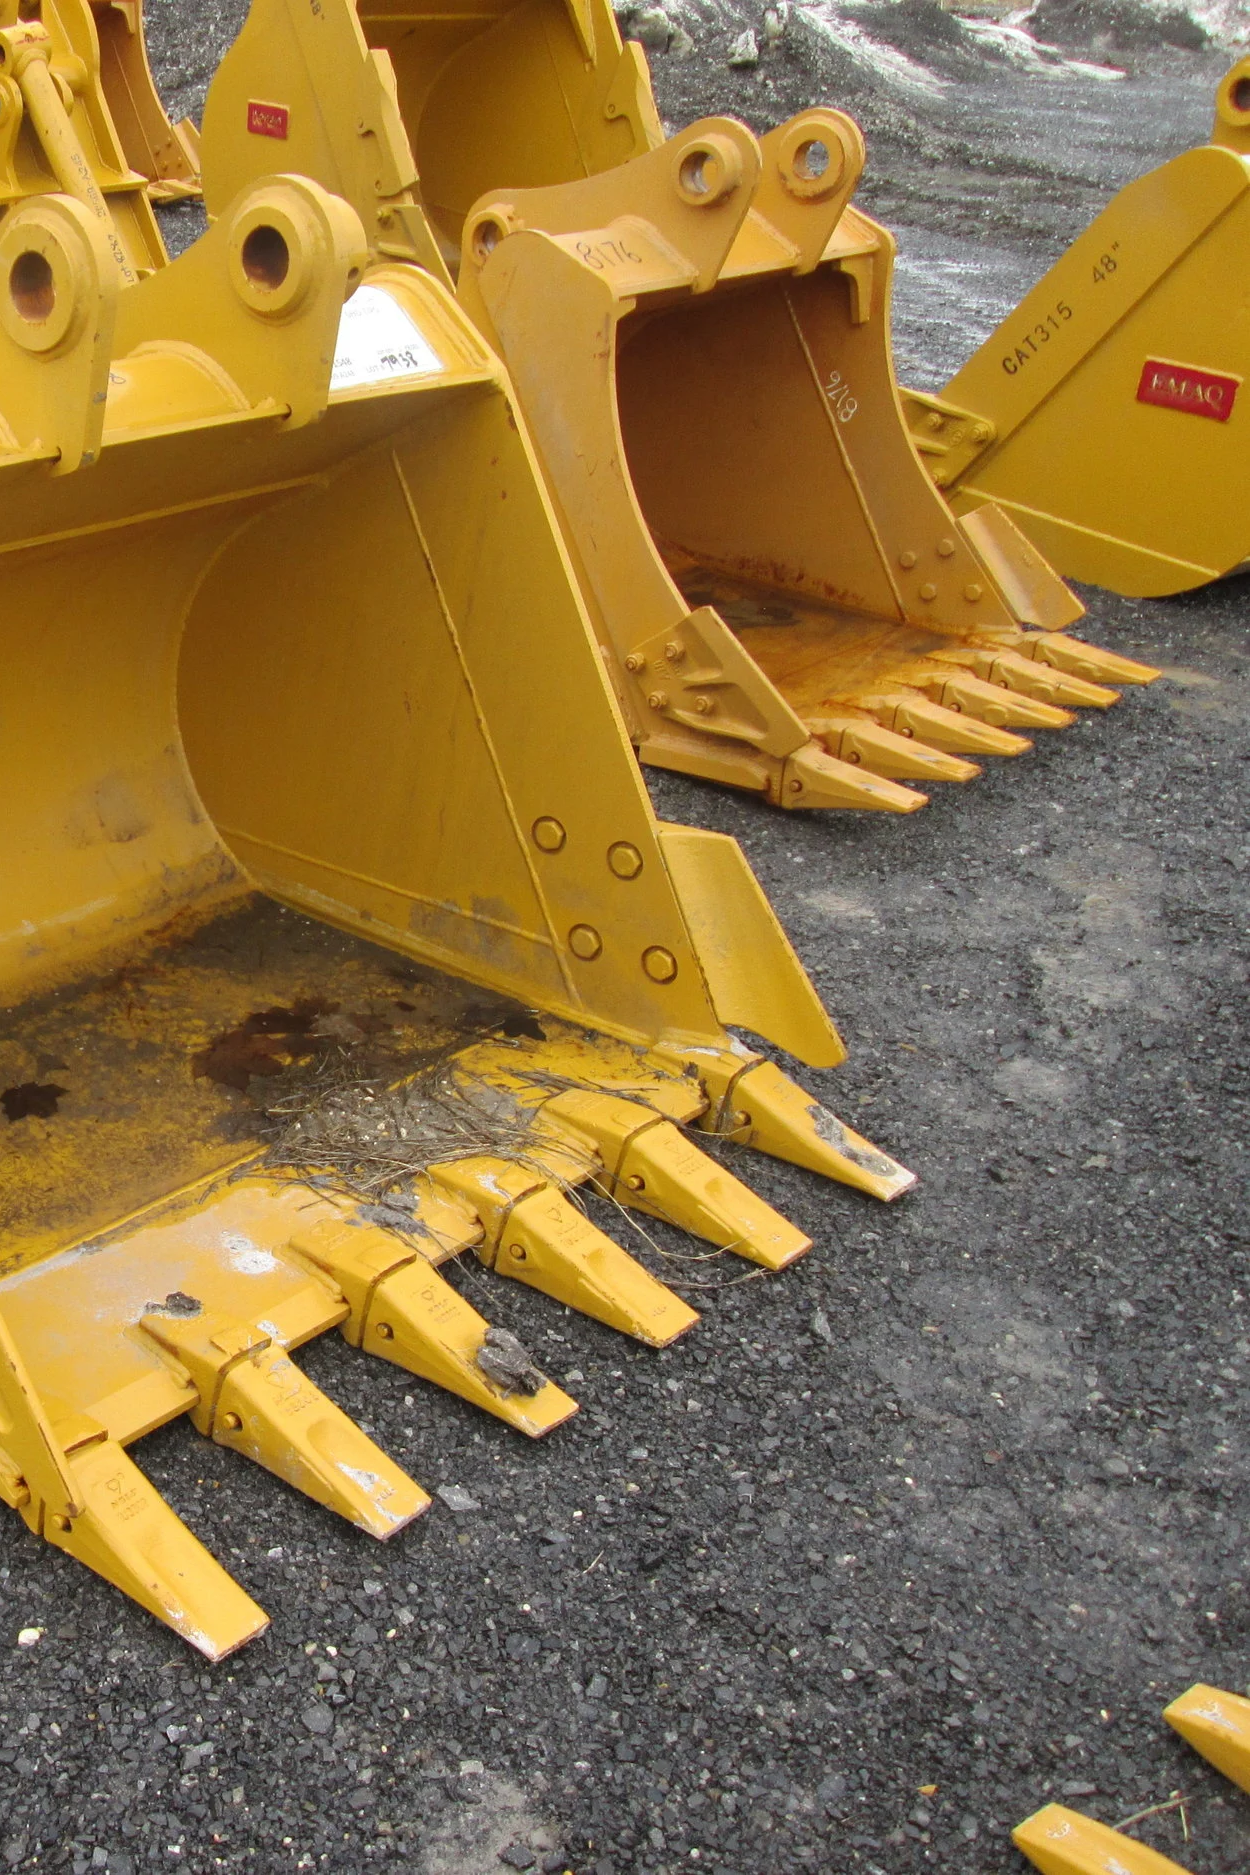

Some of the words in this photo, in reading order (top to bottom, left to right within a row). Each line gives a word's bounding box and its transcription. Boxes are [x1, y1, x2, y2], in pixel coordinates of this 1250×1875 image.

[576, 241, 643, 270] 8176
[1002, 301, 1073, 376] CAT315
[1091, 241, 1121, 284] 48"
[826, 370, 858, 423] 8176
